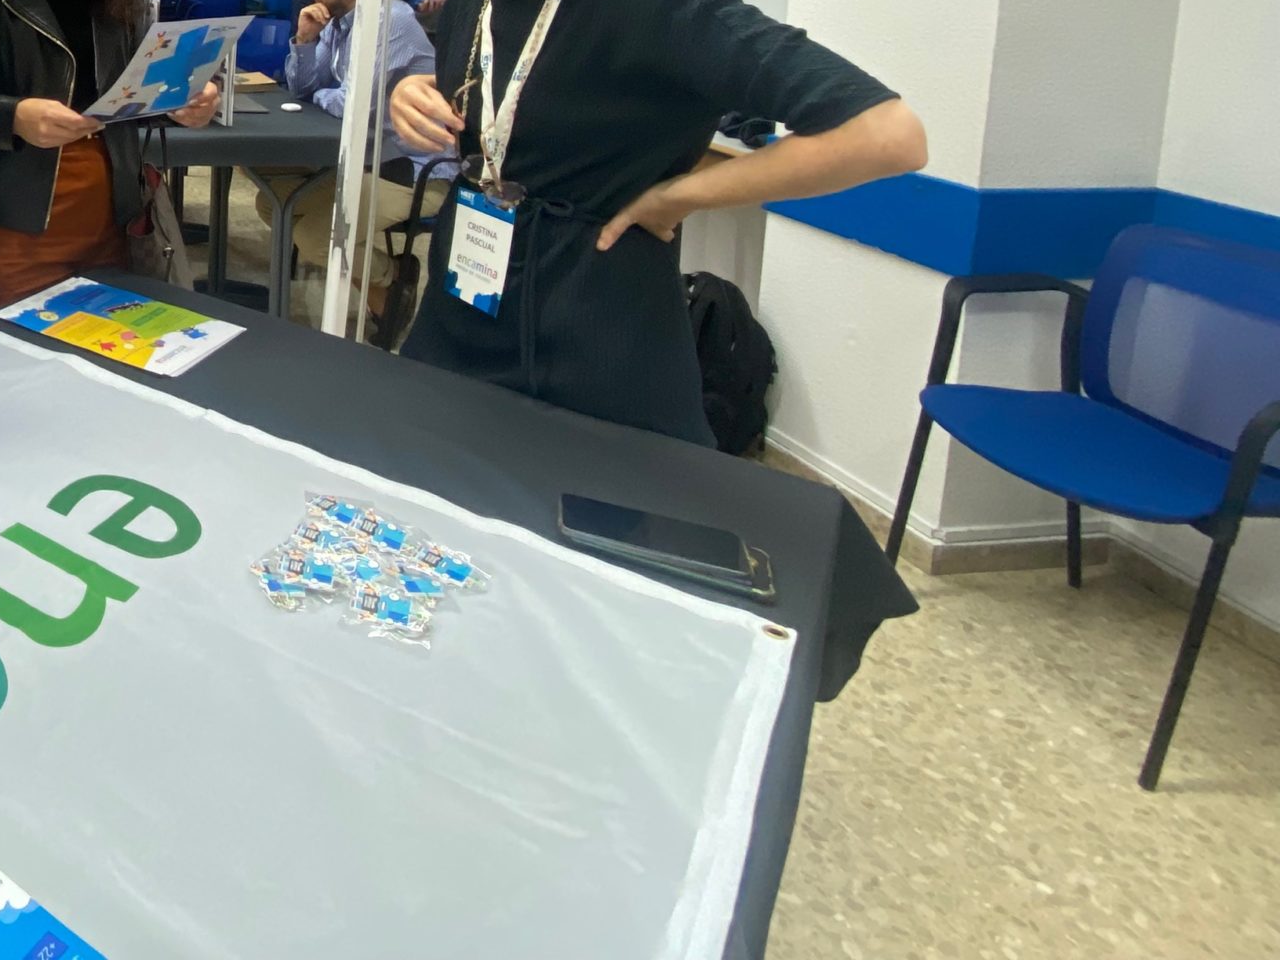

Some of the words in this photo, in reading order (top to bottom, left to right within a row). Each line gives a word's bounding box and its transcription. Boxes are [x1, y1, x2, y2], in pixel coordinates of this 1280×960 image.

[467, 221, 498, 240] CRISTINA
[466, 233, 495, 254] PASCUAL
[456, 253, 498, 279] encamina
